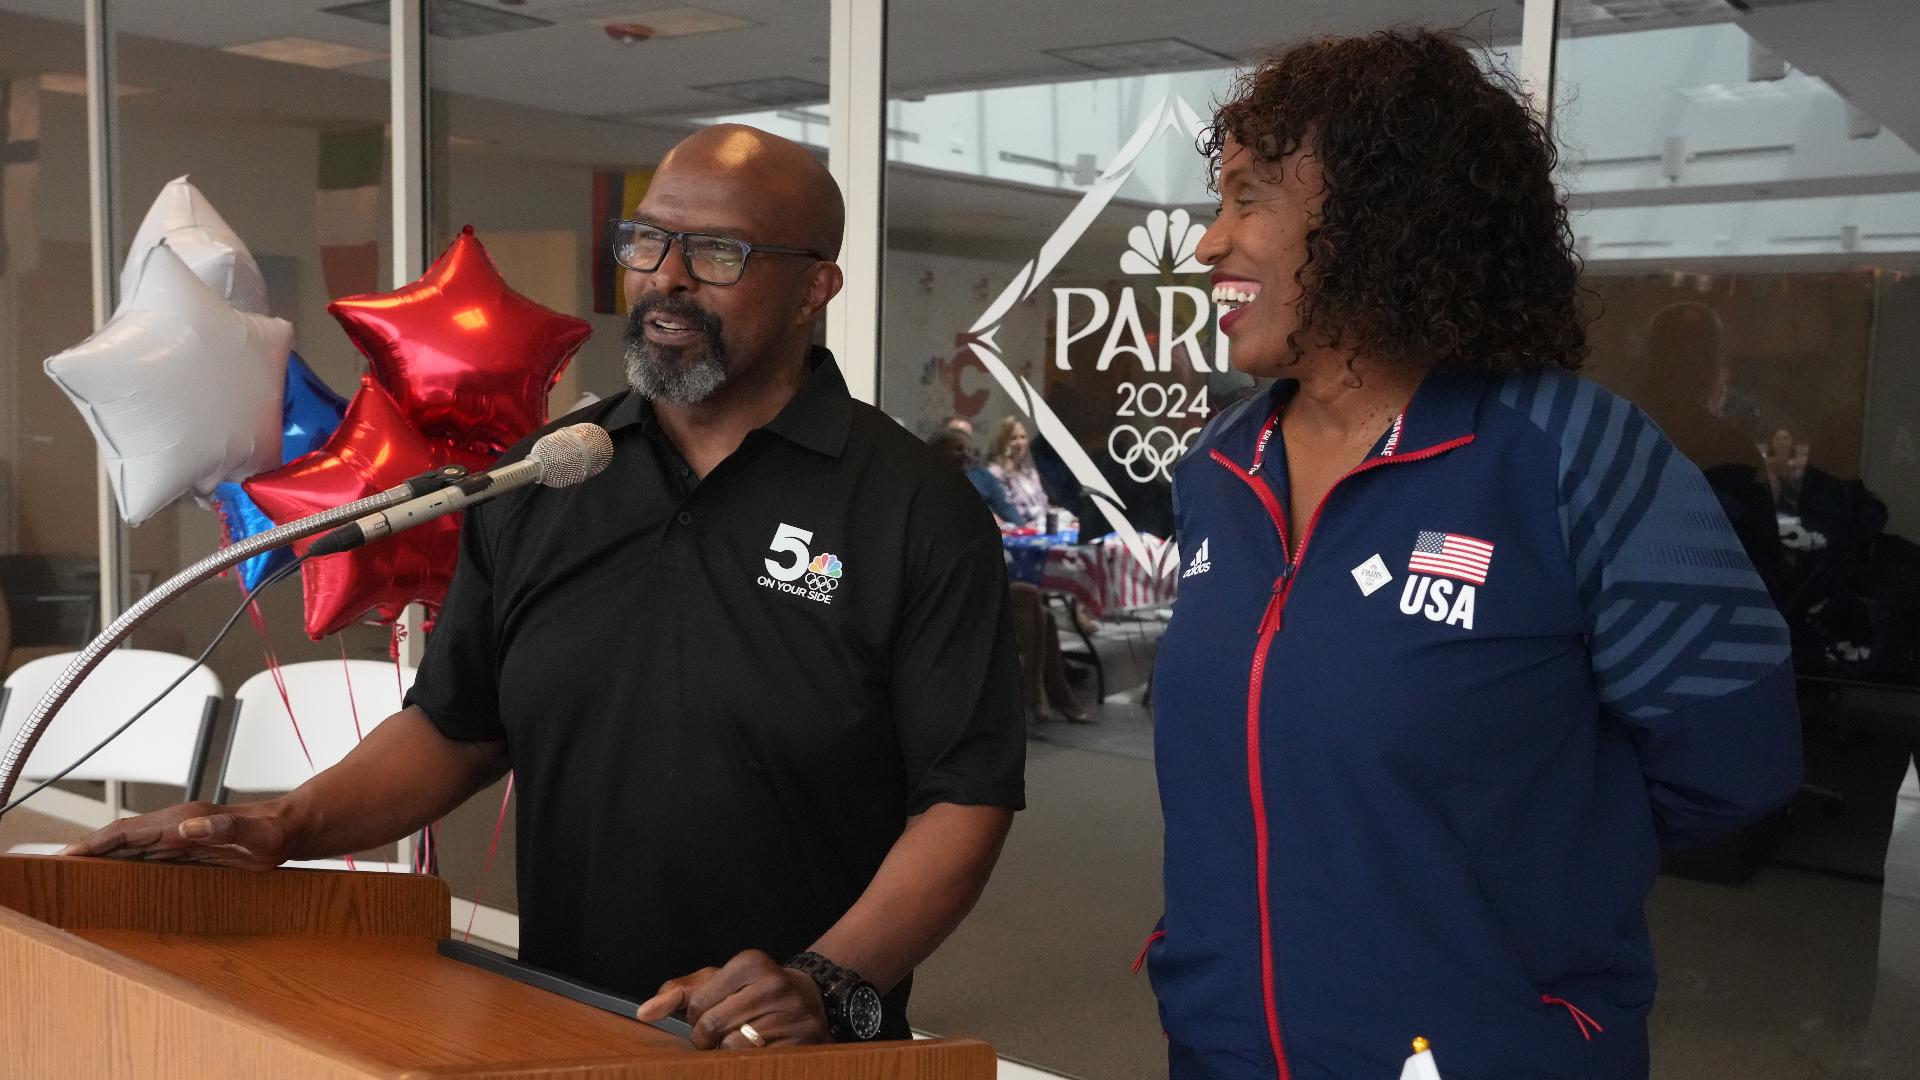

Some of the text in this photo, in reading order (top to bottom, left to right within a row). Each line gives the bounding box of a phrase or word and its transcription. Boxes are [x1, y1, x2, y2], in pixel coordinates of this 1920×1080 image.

[1052, 286, 1230, 373] PARI
[1116, 382, 1211, 418] 2024
[765, 523, 813, 581] 5
[1182, 561, 1212, 579] adidas
[757, 575, 833, 604] ON YOUR SIDE
[1399, 574, 1476, 631] USA
